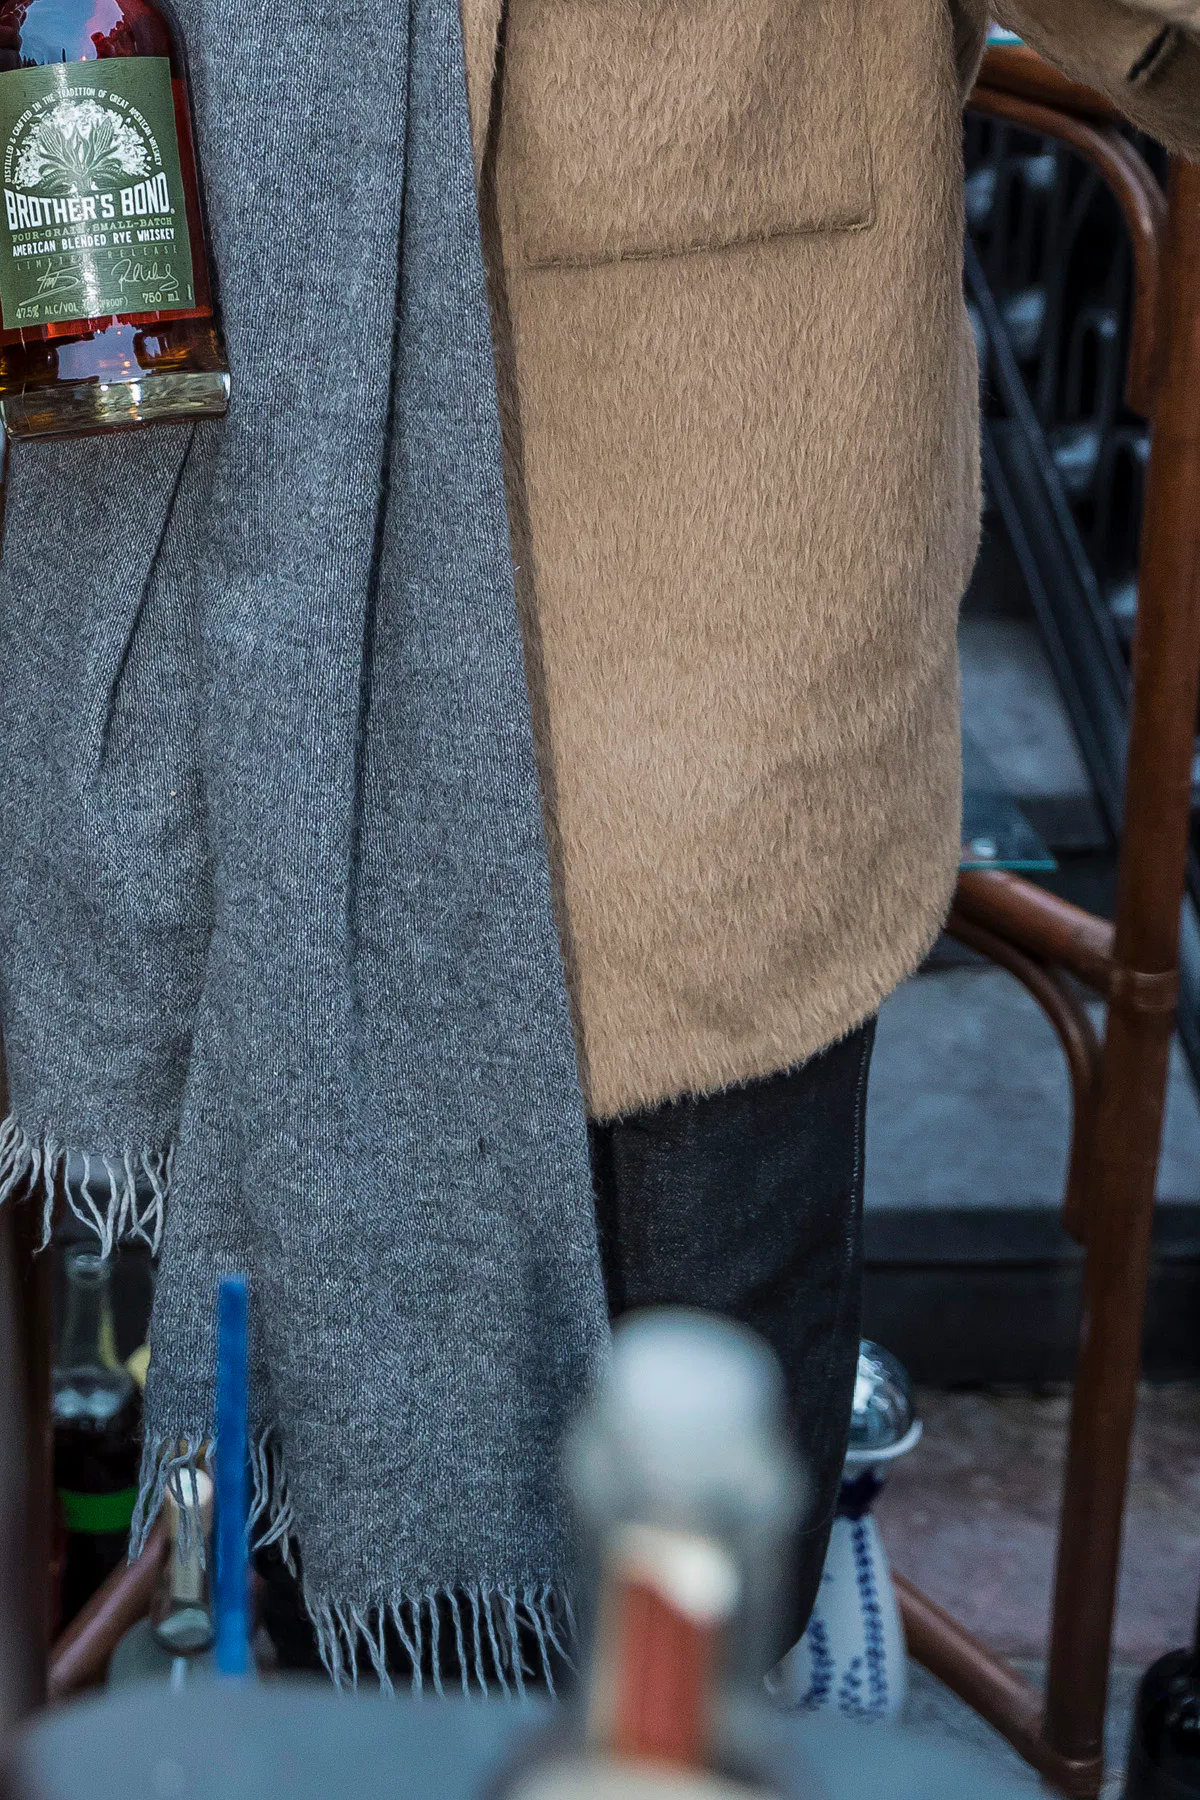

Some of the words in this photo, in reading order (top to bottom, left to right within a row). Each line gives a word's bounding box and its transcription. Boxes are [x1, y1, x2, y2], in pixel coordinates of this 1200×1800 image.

[4, 144, 14, 183] DISTILLED
[12, 109, 33, 137] CRAFTED
[32, 102, 43, 113] IN
[42, 93, 56, 105] THE
[57, 87, 97, 99] TRADITION
[97, 88, 106, 98] OF
[109, 92, 130, 110] GREAT
[128, 106, 153, 137] AMERICAN
[148, 133, 163, 167] WHISKEY
[3, 188, 115, 231] BROTHER'S
[93, 217, 173, 232] SMALL-BATCH
[12, 240, 56, 257] AMERICAN
[62, 234, 107, 250] BLENDED
[113, 231, 132, 244] RYE
[137, 227, 175, 242] WHISKEY
[107, 244, 178, 259] RELEASE
[142, 293, 162, 304] 750
[167, 291, 180, 302] ml
[44, 302, 79, 316] ALC/VOL
